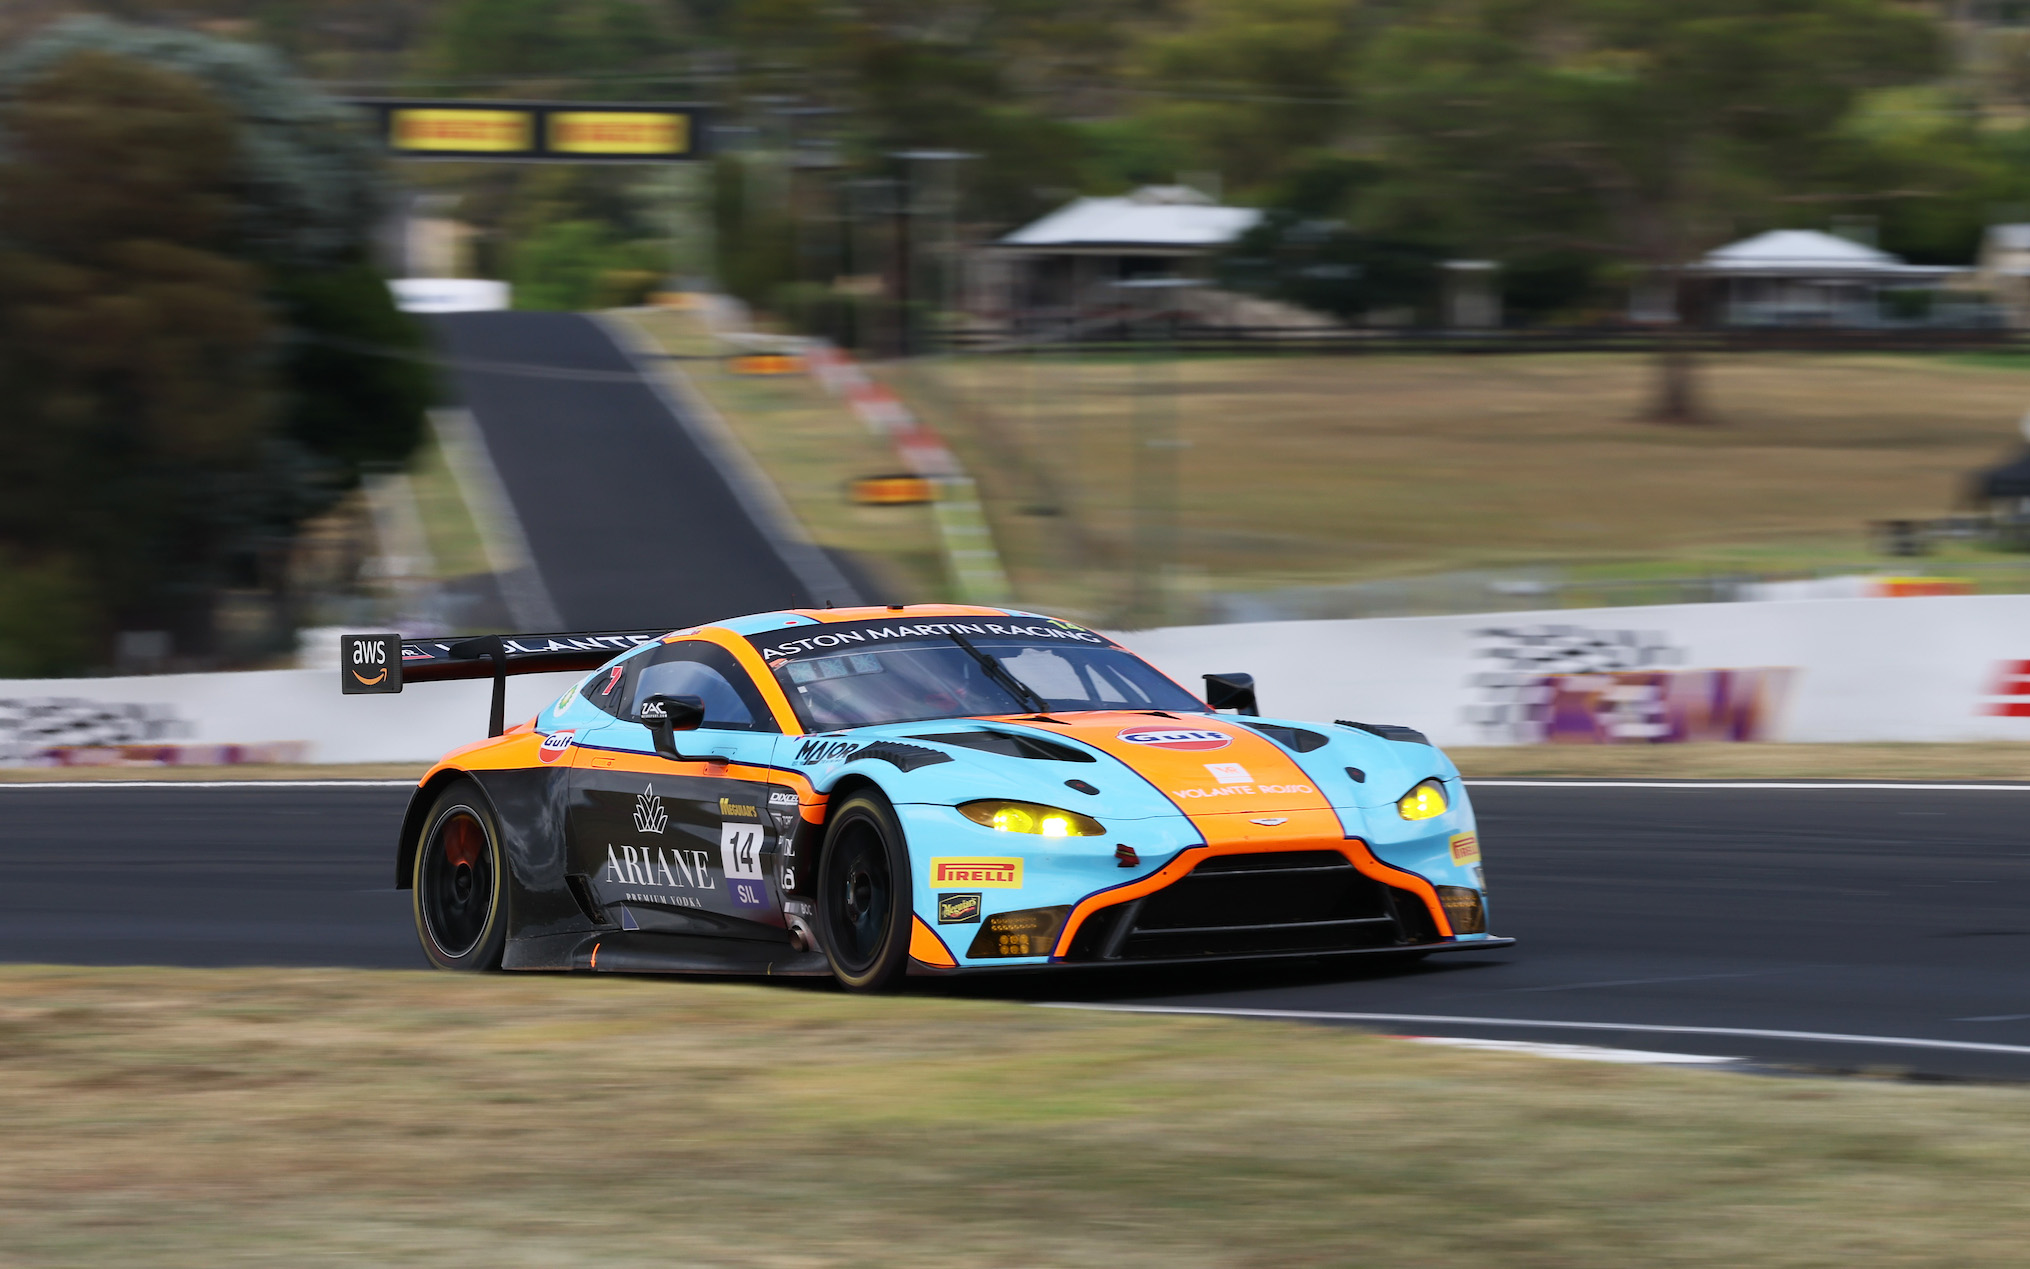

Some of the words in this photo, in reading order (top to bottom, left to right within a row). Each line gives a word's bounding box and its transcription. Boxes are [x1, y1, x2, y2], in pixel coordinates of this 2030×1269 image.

[1046, 619, 1087, 632] 14
[434, 634, 651, 653] LANTE
[763, 630, 866, 660] ASTON
[866, 623, 986, 640] MARTIN
[984, 623, 1102, 643] RACING
[352, 639, 386, 665] aws
[641, 702, 667, 715] ZAC
[544, 734, 573, 747] Gulf
[1124, 731, 1225, 742] Gulf
[795, 739, 859, 766] MAJOR
[1172, 785, 1257, 799] VOLANTE
[1257, 784, 1314, 795] ROSSO
[729, 831, 755, 873] 14
[606, 843, 715, 889] ARIANE
[937, 863, 1015, 882] PIRELLI
[625, 892, 667, 905] PREMIUM
[669, 894, 702, 908] VODKA
[737, 884, 760, 904] SIL
